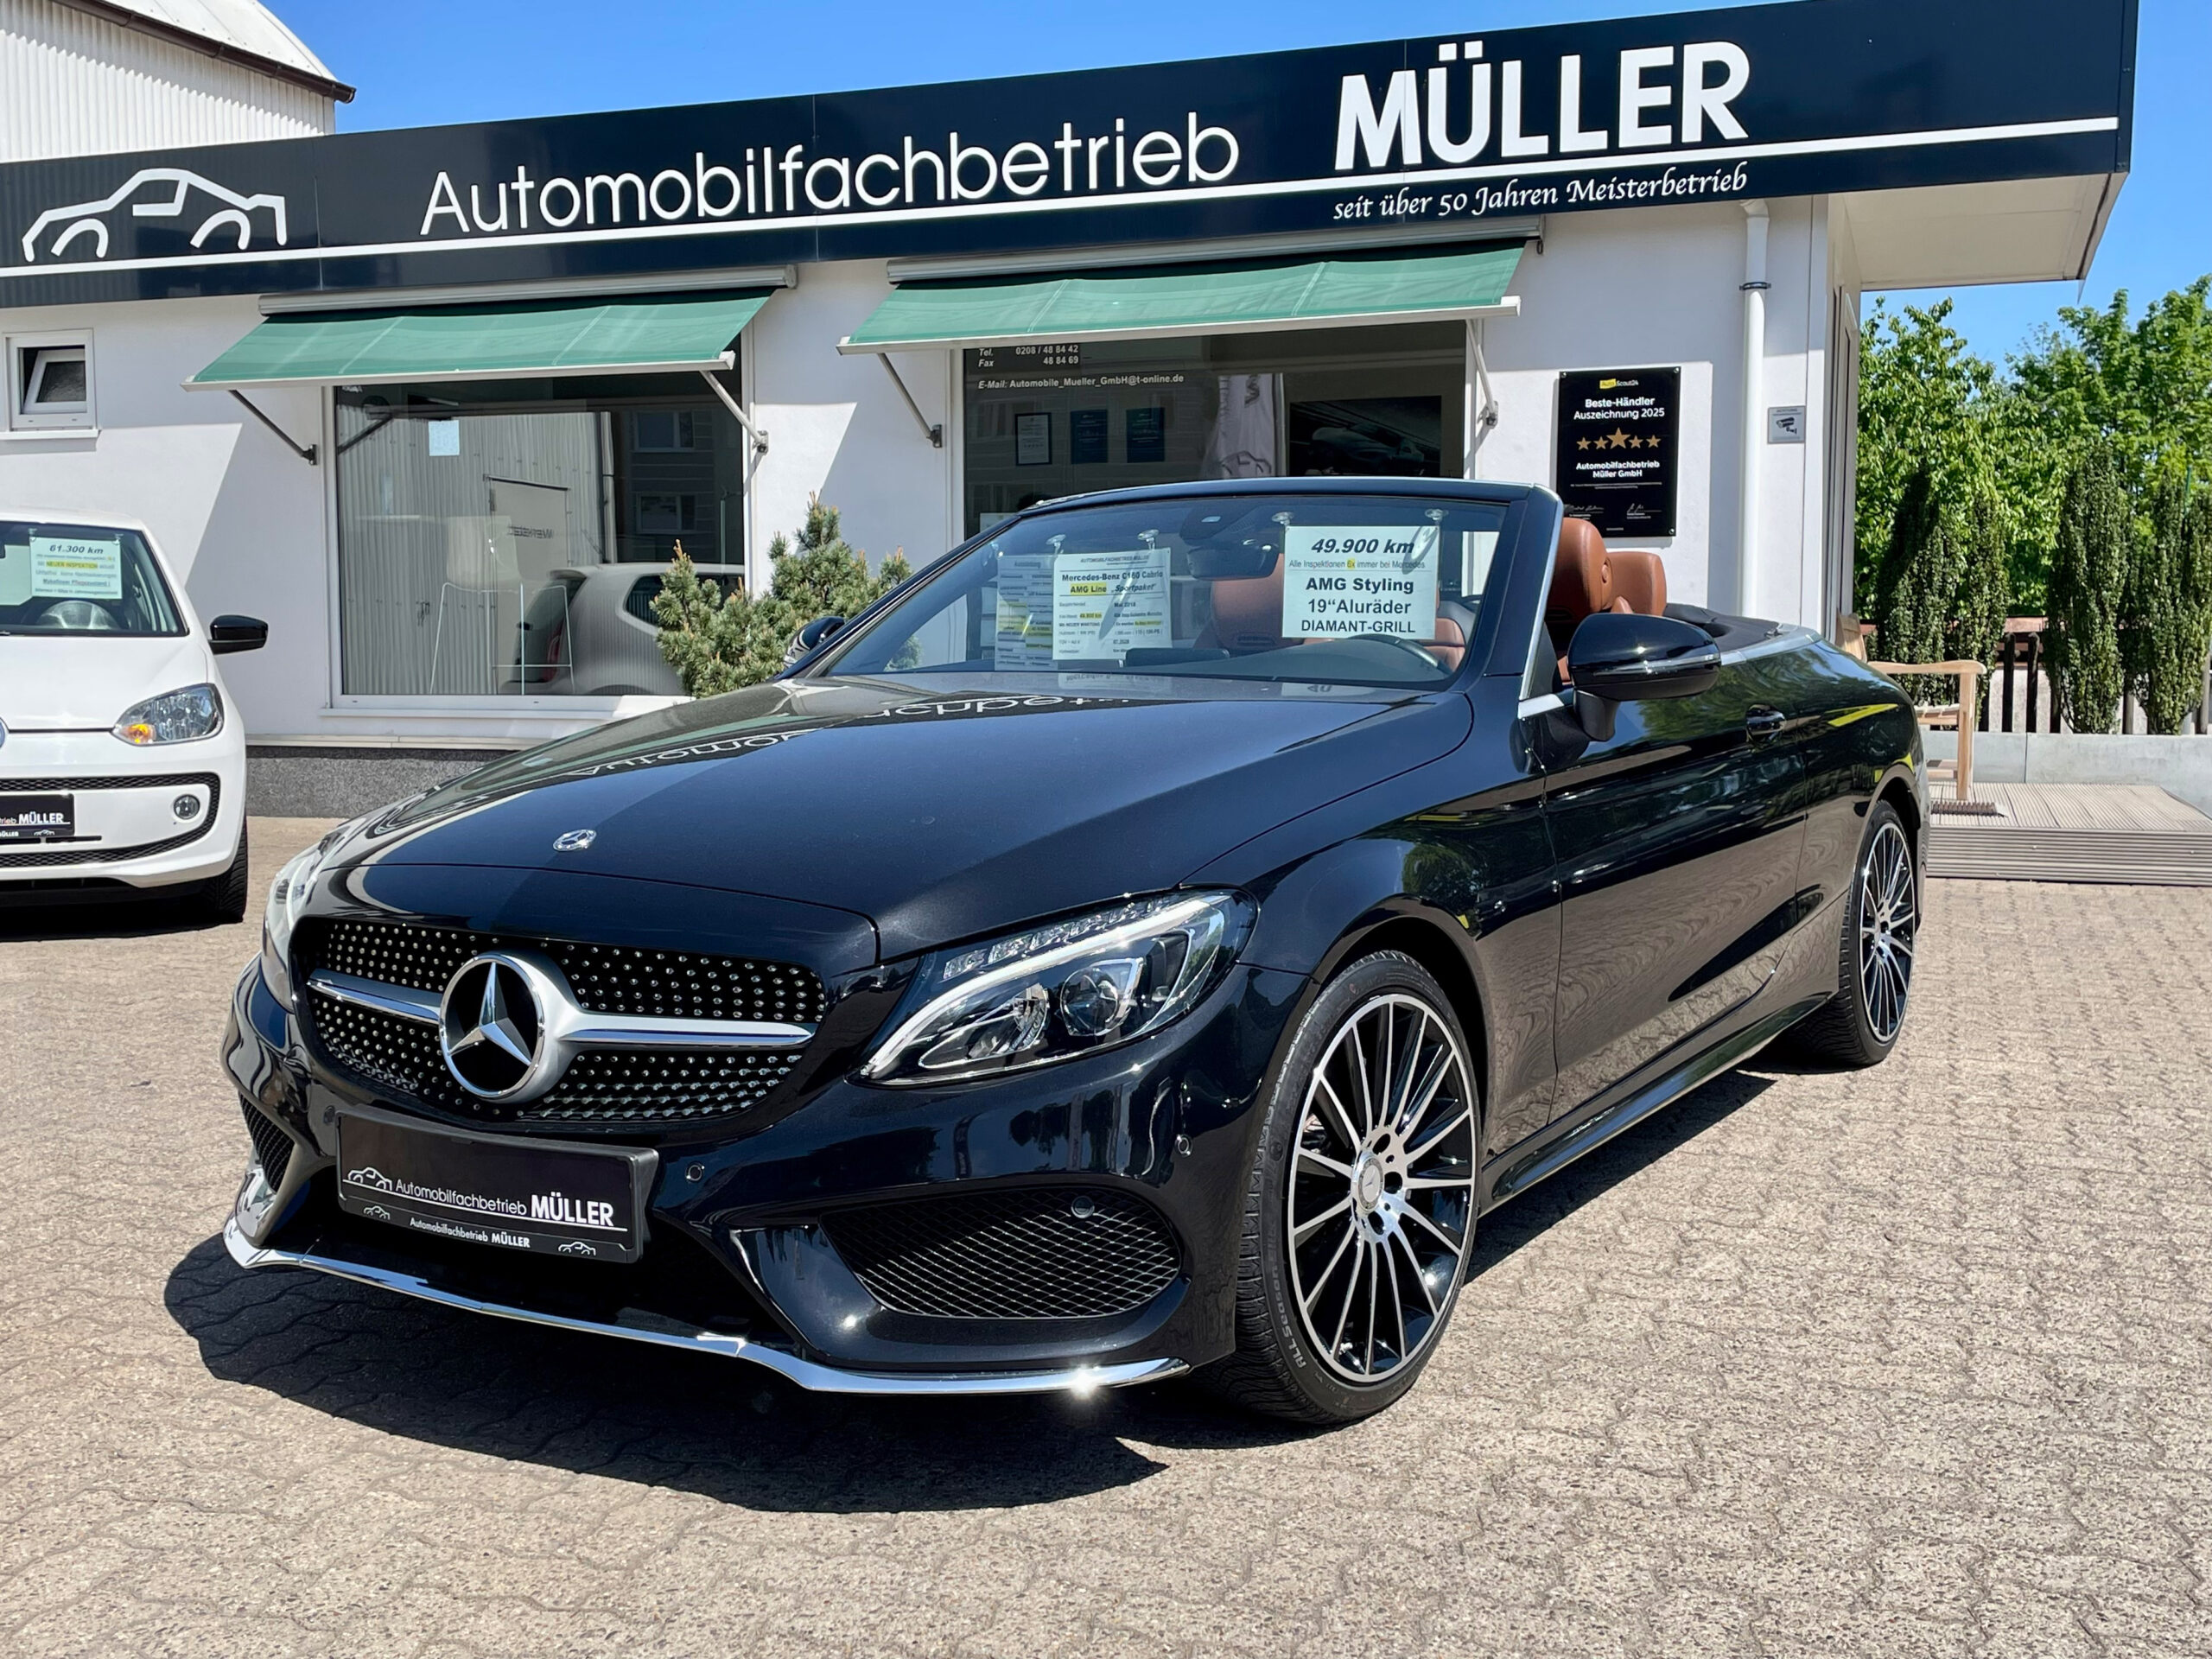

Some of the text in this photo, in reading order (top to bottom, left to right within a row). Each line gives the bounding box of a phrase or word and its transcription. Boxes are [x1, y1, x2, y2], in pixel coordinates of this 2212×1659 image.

[419, 40, 1751, 236] Automobilfachbetrieb MÜLLER
[1333, 161, 1749, 220] seit über 50 Jahren Meisterbetrieb
[978, 348, 994, 357] Tel.
[1015, 346, 1037, 355] 0208
[1042, 346, 1054, 354] 48
[1055, 346, 1066, 354] 84
[1067, 345, 1079, 354] 42
[978, 355, 1079, 368] Fax 48 84 69
[978, 373, 1185, 390] E-Mail: Automobile_Mueller_GmbH@t-online.de
[1584, 396, 1656, 409] Beste-Händler
[1573, 407, 1666, 420] Auszeichnung 2025
[1575, 460, 1661, 471] Automobilfachbetrieb
[1592, 469, 1643, 479] Müller GmbH
[49, 544, 104, 555] 61.300 km
[1311, 538, 1415, 554] 49.900 km
[1288, 559, 1302, 568] Alle
[1303, 560, 1345, 569] Inspektionen
[1061, 573, 1121, 582] Mercedes-Benz
[1070, 585, 1089, 594] AMG
[1090, 584, 1108, 593] Line
[1305, 577, 1414, 594] AMG Styling
[1300, 619, 1416, 633] DIAMANT-GRILL
[18, 810, 65, 824] MÜLLER
[395, 1179, 614, 1227] Automobilfachbetrieb MÜLLER
[409, 1217, 531, 1249] Automobilfachbetrieb MÜLLER
